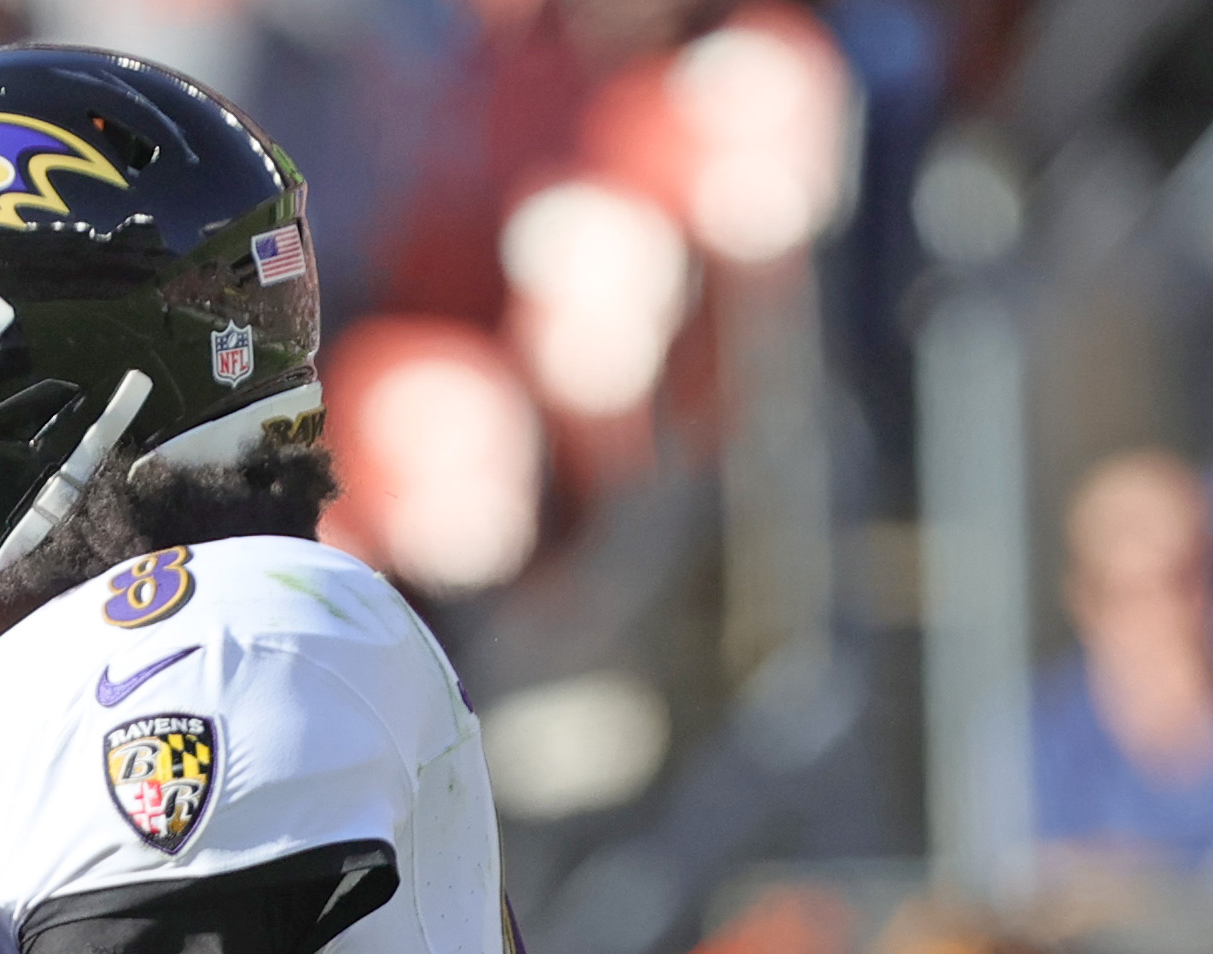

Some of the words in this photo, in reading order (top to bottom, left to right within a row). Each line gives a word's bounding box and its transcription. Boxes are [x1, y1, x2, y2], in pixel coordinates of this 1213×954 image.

[220, 349, 249, 376] NFL
[102, 545, 196, 630] 8
[107, 717, 205, 748] RAVENS
